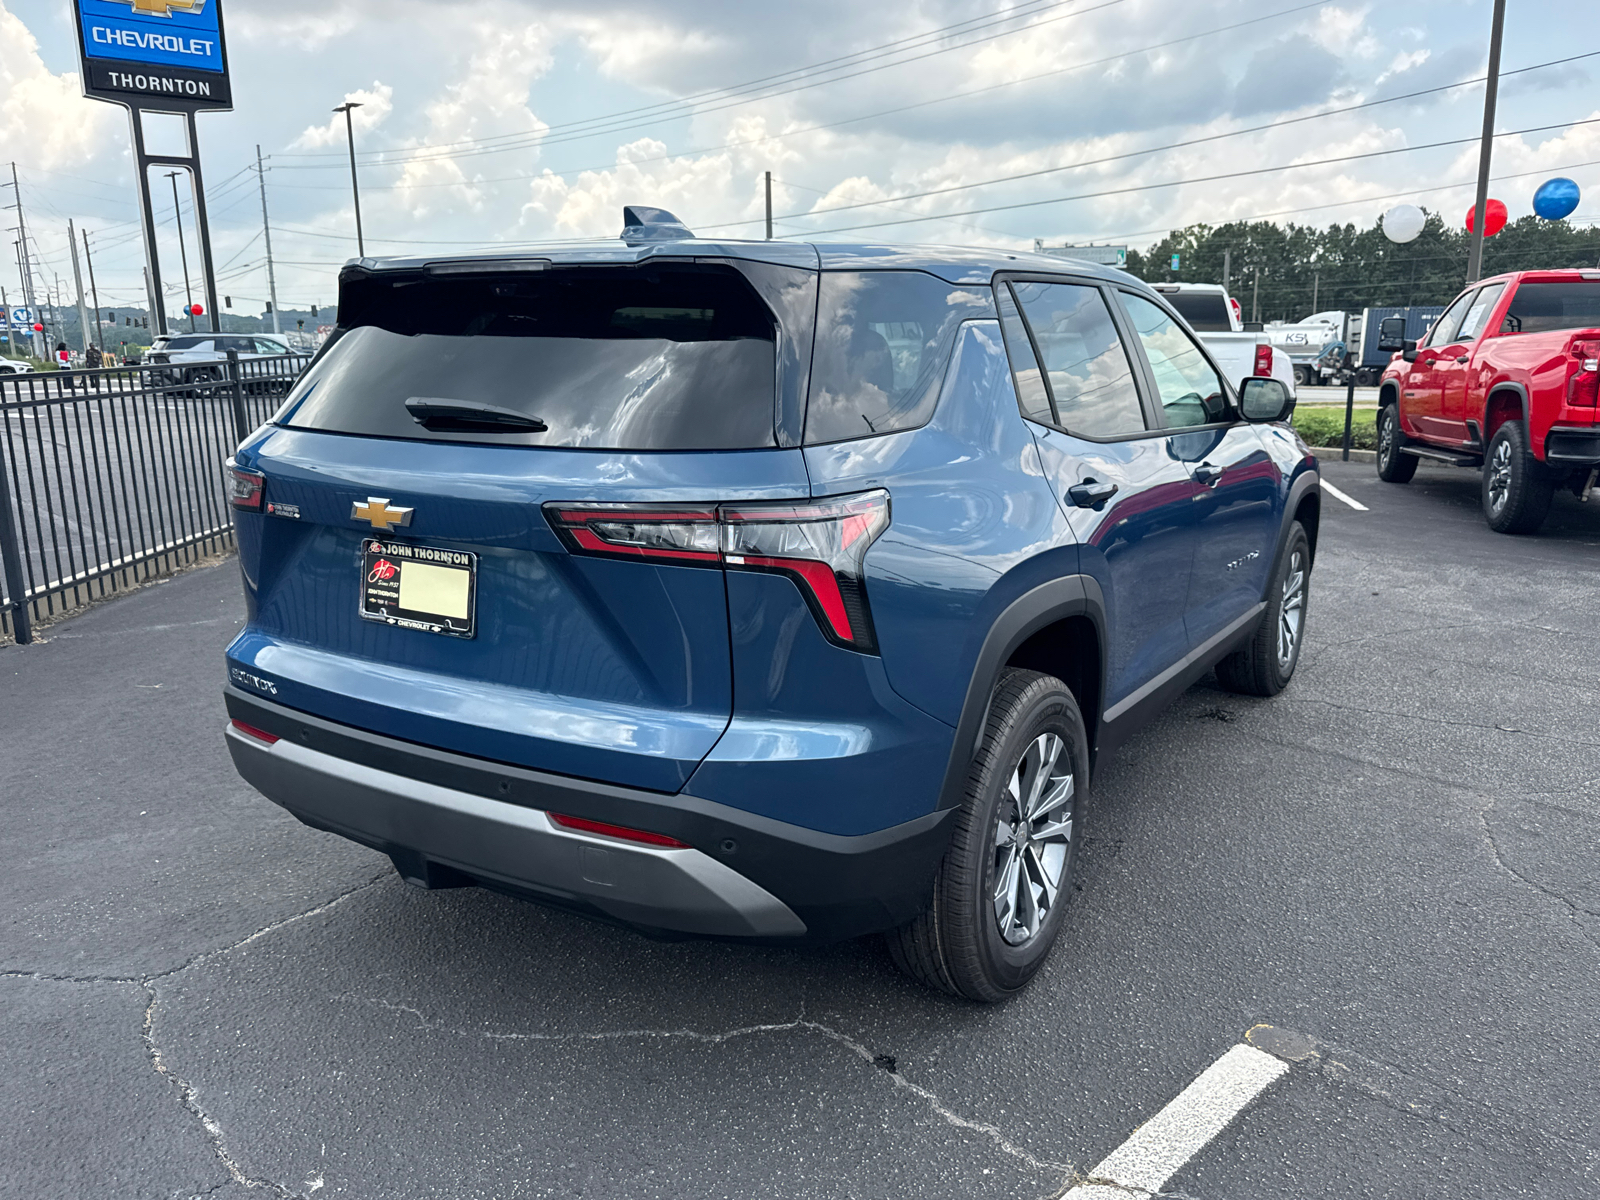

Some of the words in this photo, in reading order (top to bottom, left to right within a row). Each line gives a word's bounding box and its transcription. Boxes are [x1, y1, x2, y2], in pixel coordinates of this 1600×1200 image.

[92, 26, 214, 57] CHEVROLET
[108, 72, 211, 96] THORNTON
[386, 544, 412, 557] JOHN
[413, 547, 469, 565] THORNTON
[397, 619, 430, 631] CHEVROLET
